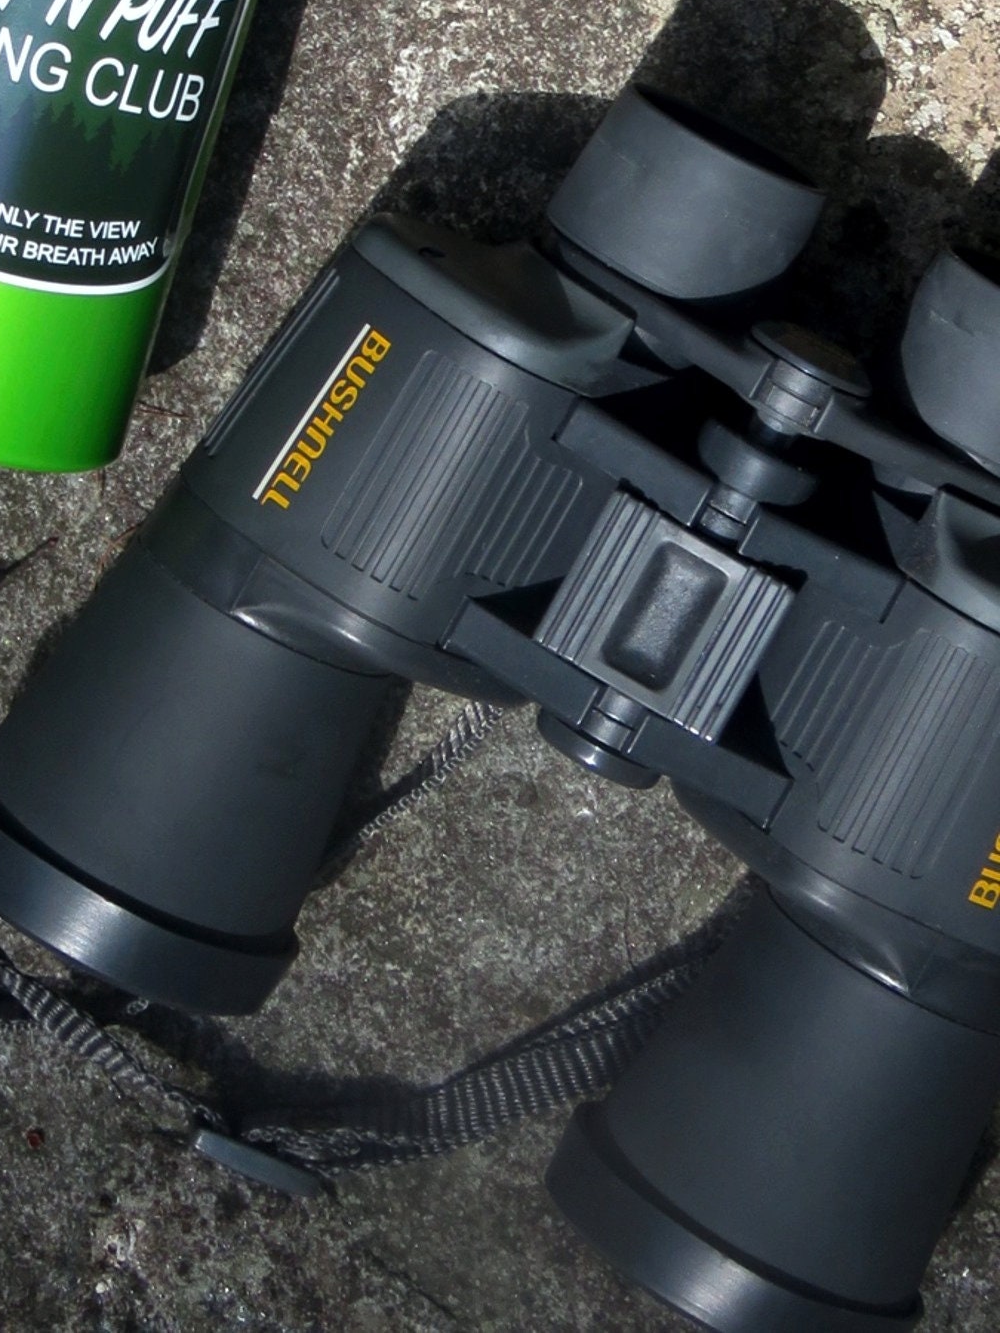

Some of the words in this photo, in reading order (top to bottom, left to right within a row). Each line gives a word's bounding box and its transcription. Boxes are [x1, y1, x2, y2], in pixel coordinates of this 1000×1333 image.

[86, 58, 205, 122] CLUB
[44, 213, 85, 238] THE
[89, 221, 141, 239] VIEW
[23, 240, 106, 267] BREATH
[107, 237, 158, 266] AWAY
[259, 330, 393, 511] BUSHNELL
